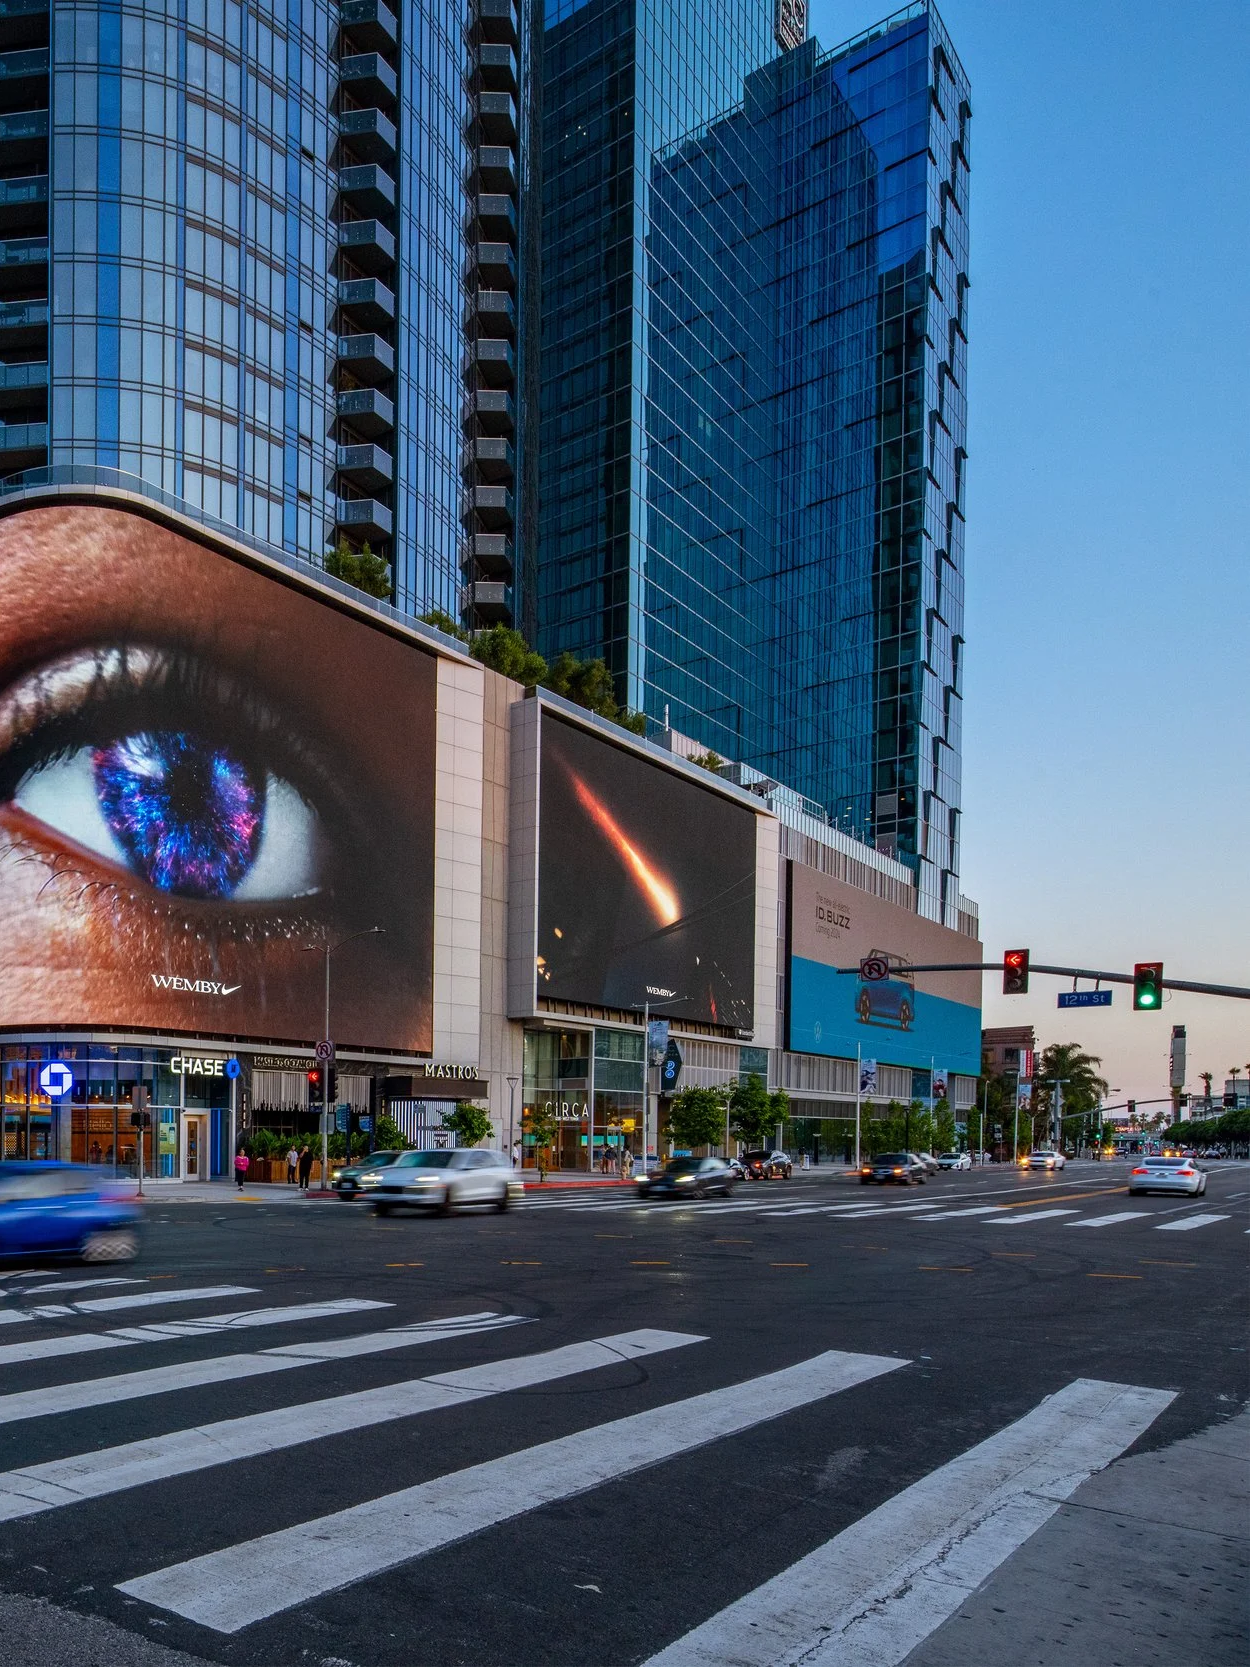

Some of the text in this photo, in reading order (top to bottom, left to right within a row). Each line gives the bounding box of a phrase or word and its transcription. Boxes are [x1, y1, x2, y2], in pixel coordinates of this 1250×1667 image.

[151, 974, 221, 995] WEMBY
[646, 986, 670, 997] WEMBY
[1065, 994, 1105, 1005] 12th St
[170, 1057, 224, 1076] CHASE
[424, 1063, 479, 1080] MASTRO'S
[545, 1101, 590, 1118] CIRCA
